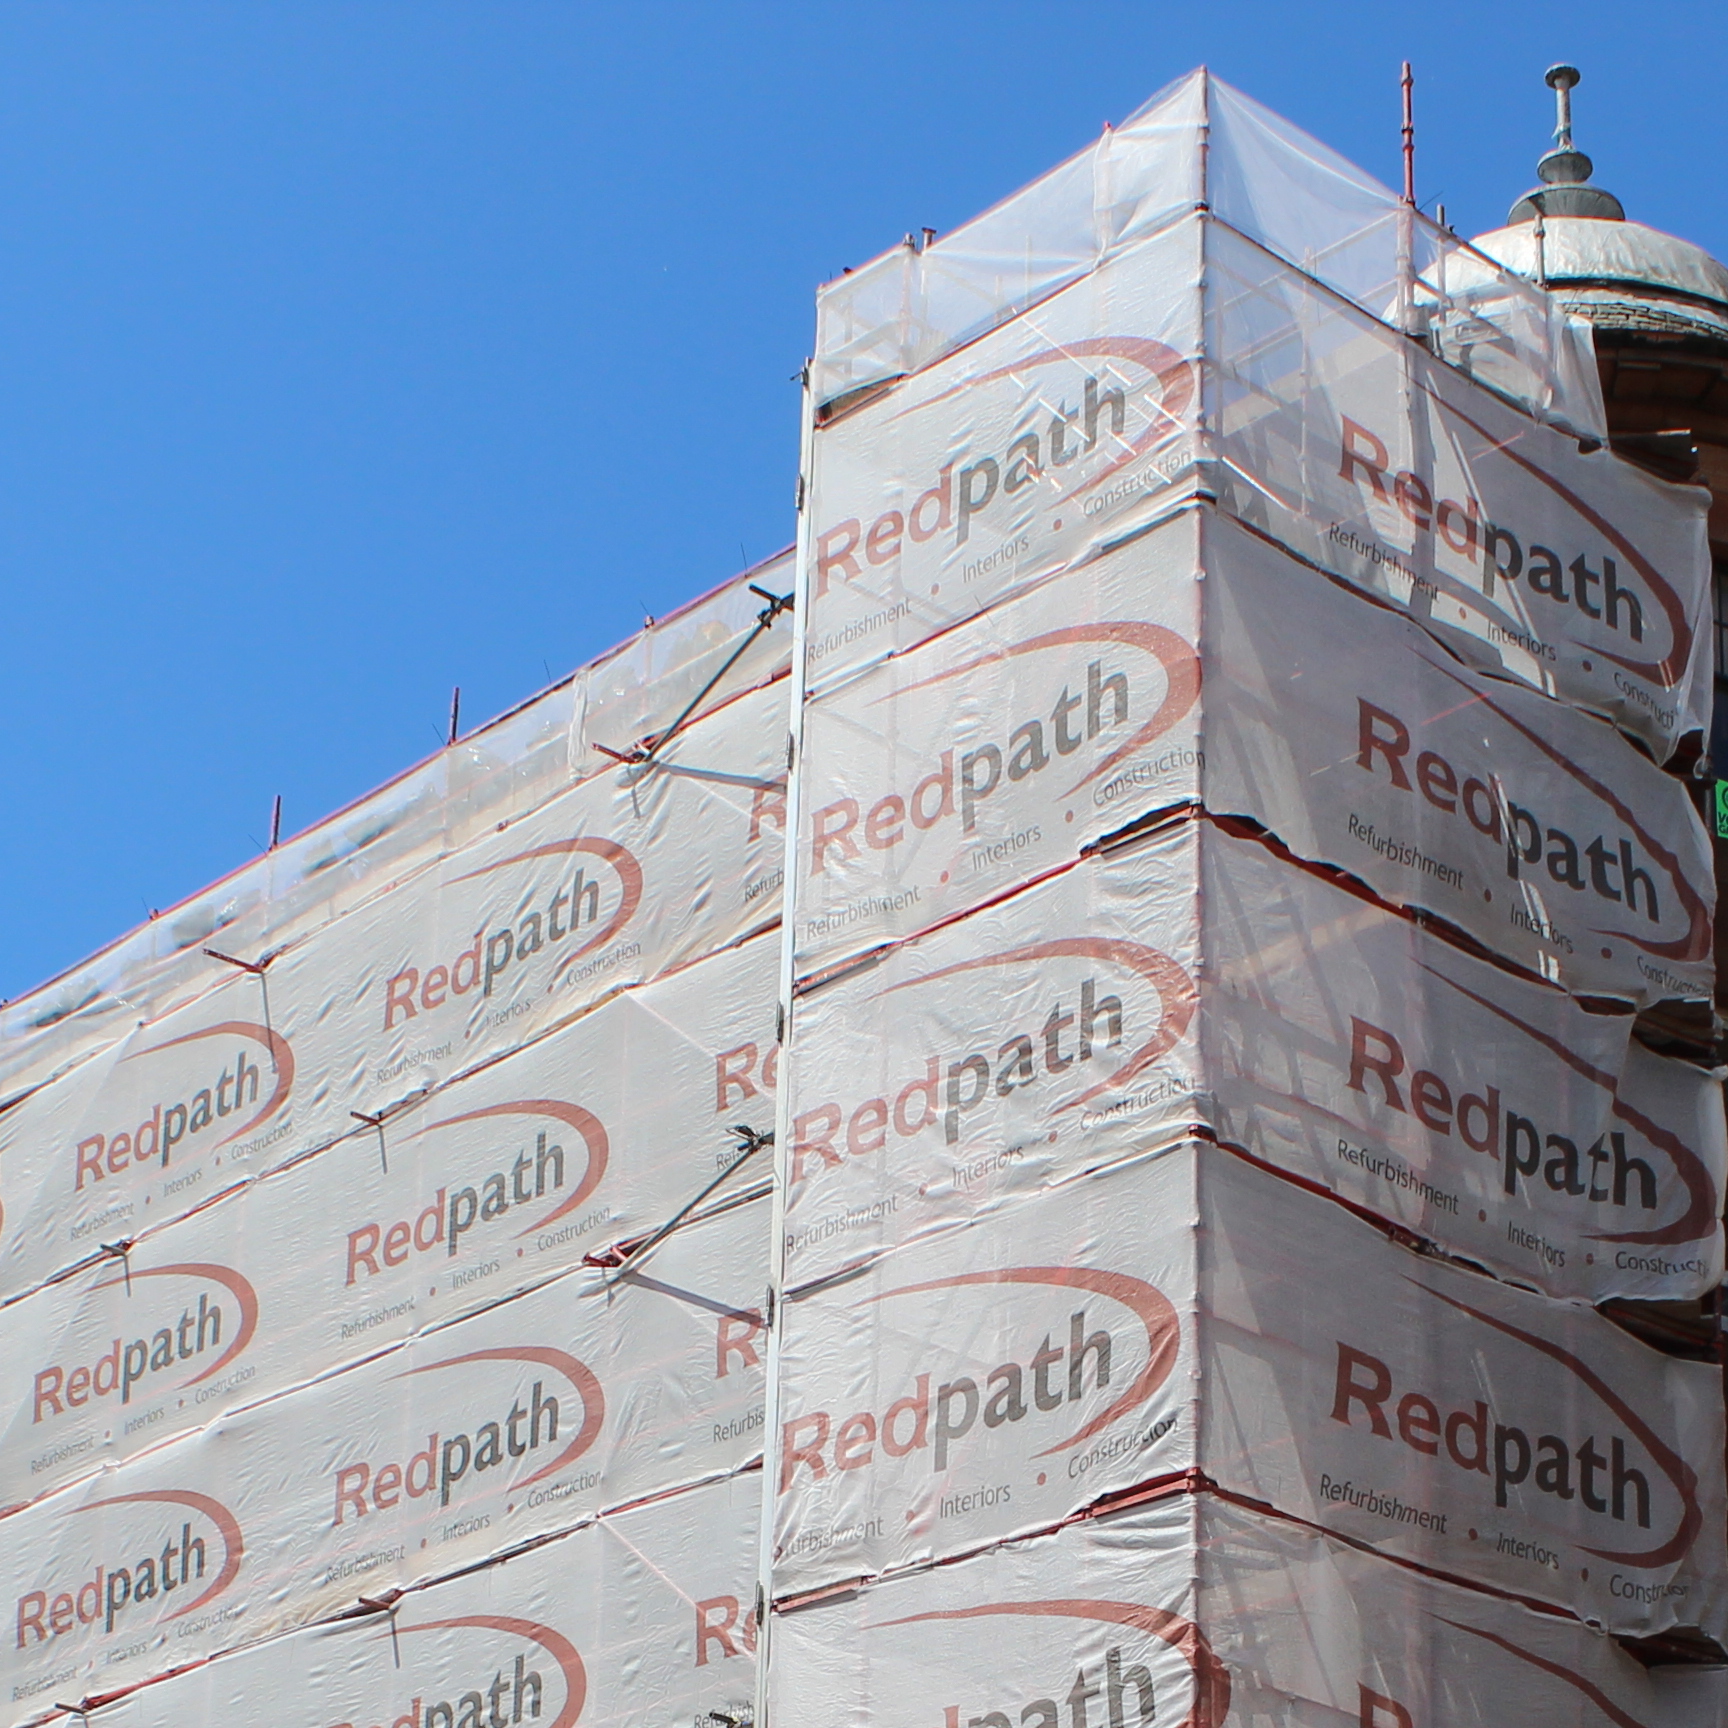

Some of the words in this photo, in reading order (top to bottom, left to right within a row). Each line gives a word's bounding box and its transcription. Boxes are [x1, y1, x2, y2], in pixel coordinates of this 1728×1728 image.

[816, 375, 1124, 599] Redpath
[962, 536, 1030, 584] Interiors
[1338, 412, 1644, 644] Redpath
[811, 660, 1129, 877] Redpath
[1356, 696, 1660, 924] Redpath
[973, 825, 1041, 870] Interiors
[1348, 812, 1464, 891] Refurbishment
[383, 867, 599, 1032] Redpath
[73, 1051, 258, 1192] Redpath
[789, 978, 1121, 1184] Redpath
[1346, 1015, 1657, 1209] Redpath
[345, 1133, 564, 1287] Redpath
[451, 1259, 500, 1290] Interiors
[537, 1206, 611, 1252] Construction
[31, 1292, 223, 1425] Redpath
[777, 1312, 1109, 1496] Redpath
[332, 1381, 559, 1527] Redpath
[939, 1483, 1010, 1518] Interiors
[1330, 1340, 1651, 1528] Redpath
[16, 1522, 204, 1649] Redpath
[1319, 1474, 1447, 1534] Refurbishment
[1497, 1533, 1560, 1570] Interiors
